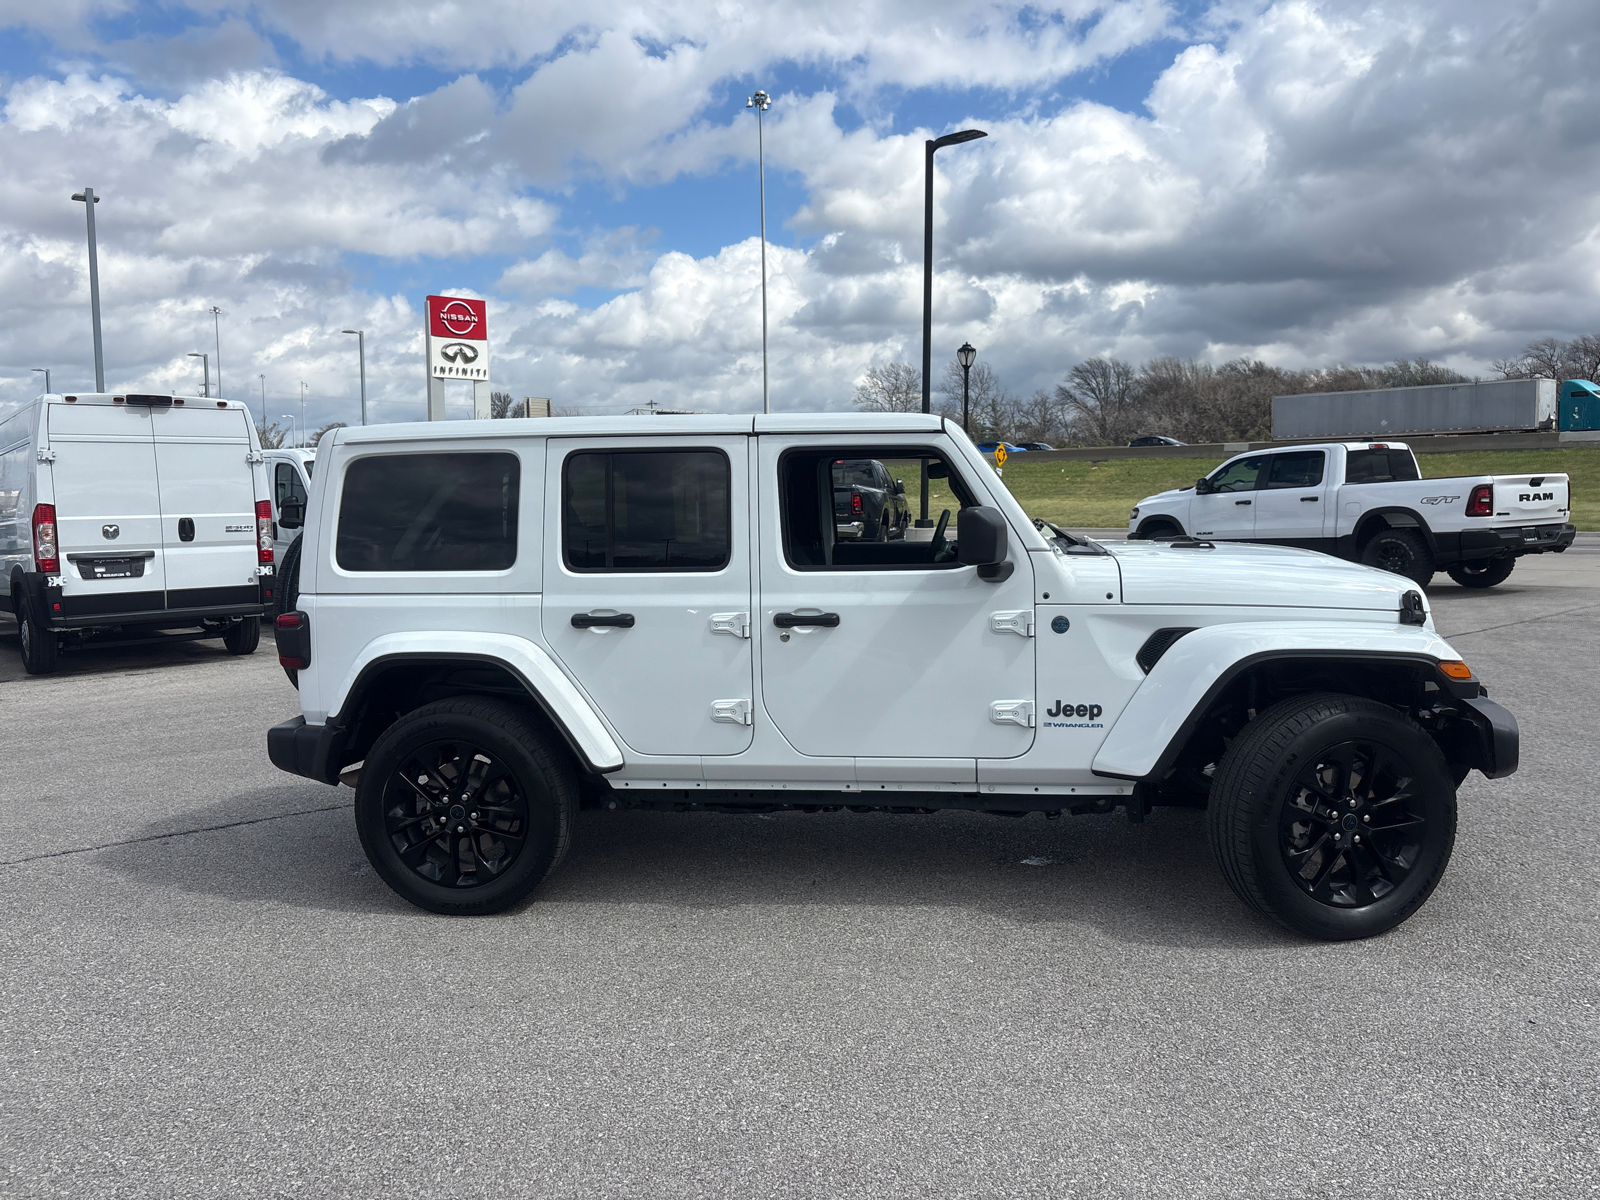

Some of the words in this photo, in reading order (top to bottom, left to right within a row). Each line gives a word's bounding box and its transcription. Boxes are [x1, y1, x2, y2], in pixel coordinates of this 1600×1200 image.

[440, 312, 478, 323] NISSAN
[433, 365, 487, 377] INFINITI
[1518, 492, 1554, 502] RAM
[1046, 699, 1103, 721] Jeep
